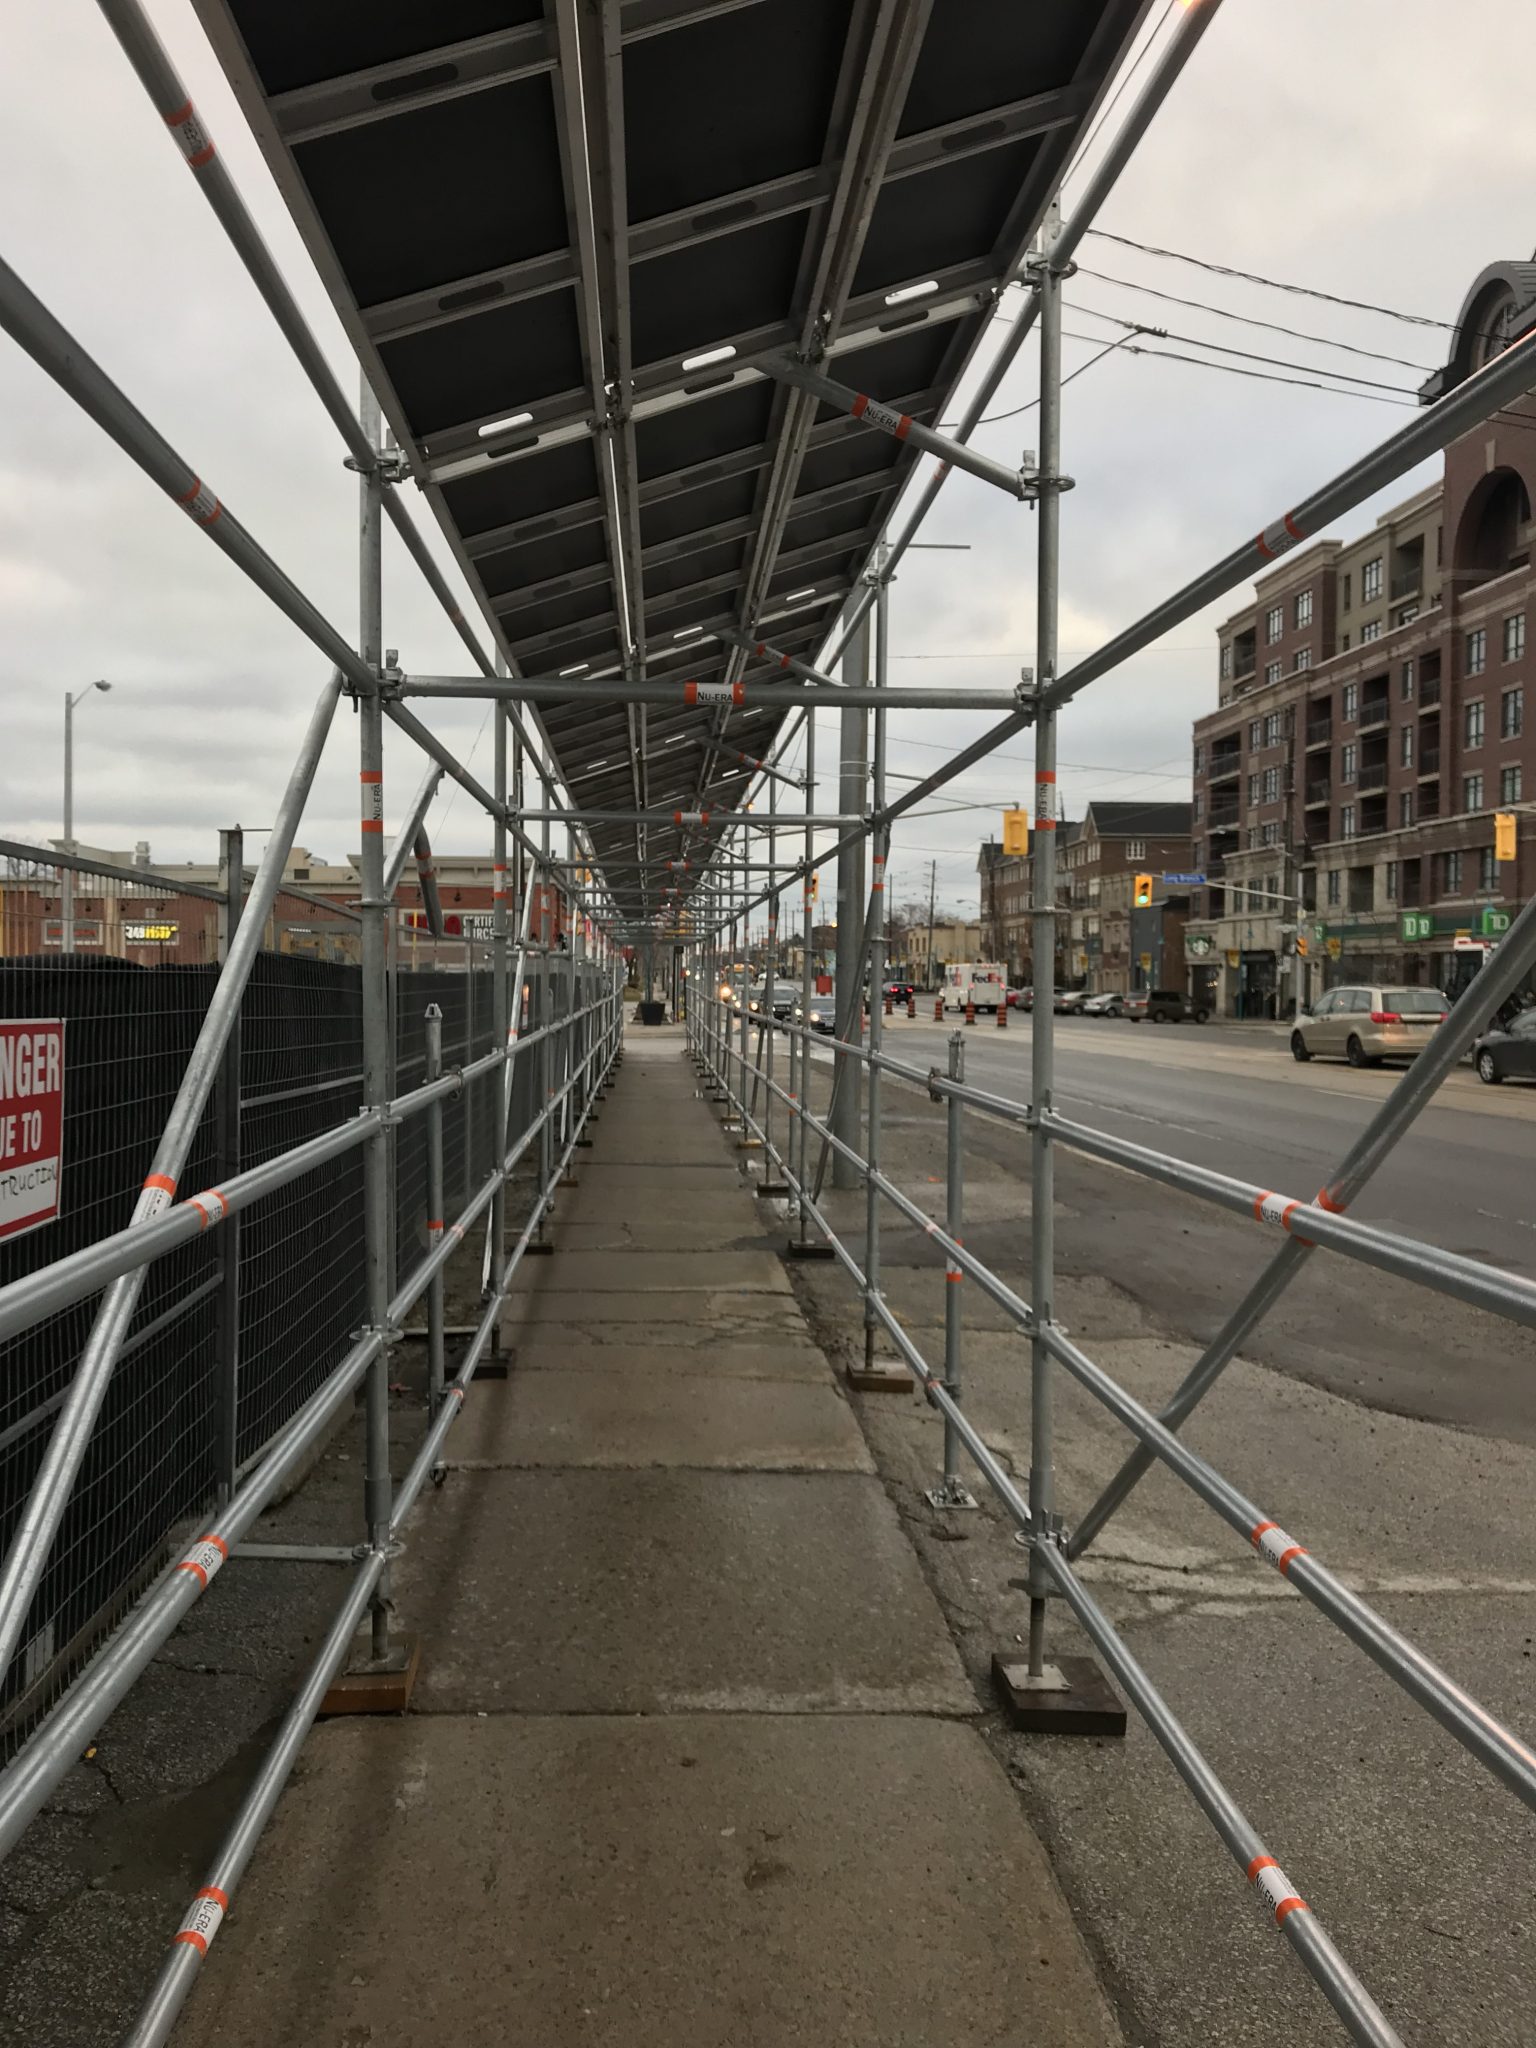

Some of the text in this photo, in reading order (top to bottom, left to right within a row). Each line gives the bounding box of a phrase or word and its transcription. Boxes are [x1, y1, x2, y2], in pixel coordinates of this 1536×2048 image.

[864, 406, 897, 429] NU-ERA
[697, 691, 733, 702] NU-ERA
[372, 783, 382, 820] NU-ERA
[1039, 783, 1049, 819] NU-ERA
[21, 1109, 42, 1153] TO
[193, 1898, 220, 1934] NU-ERA
